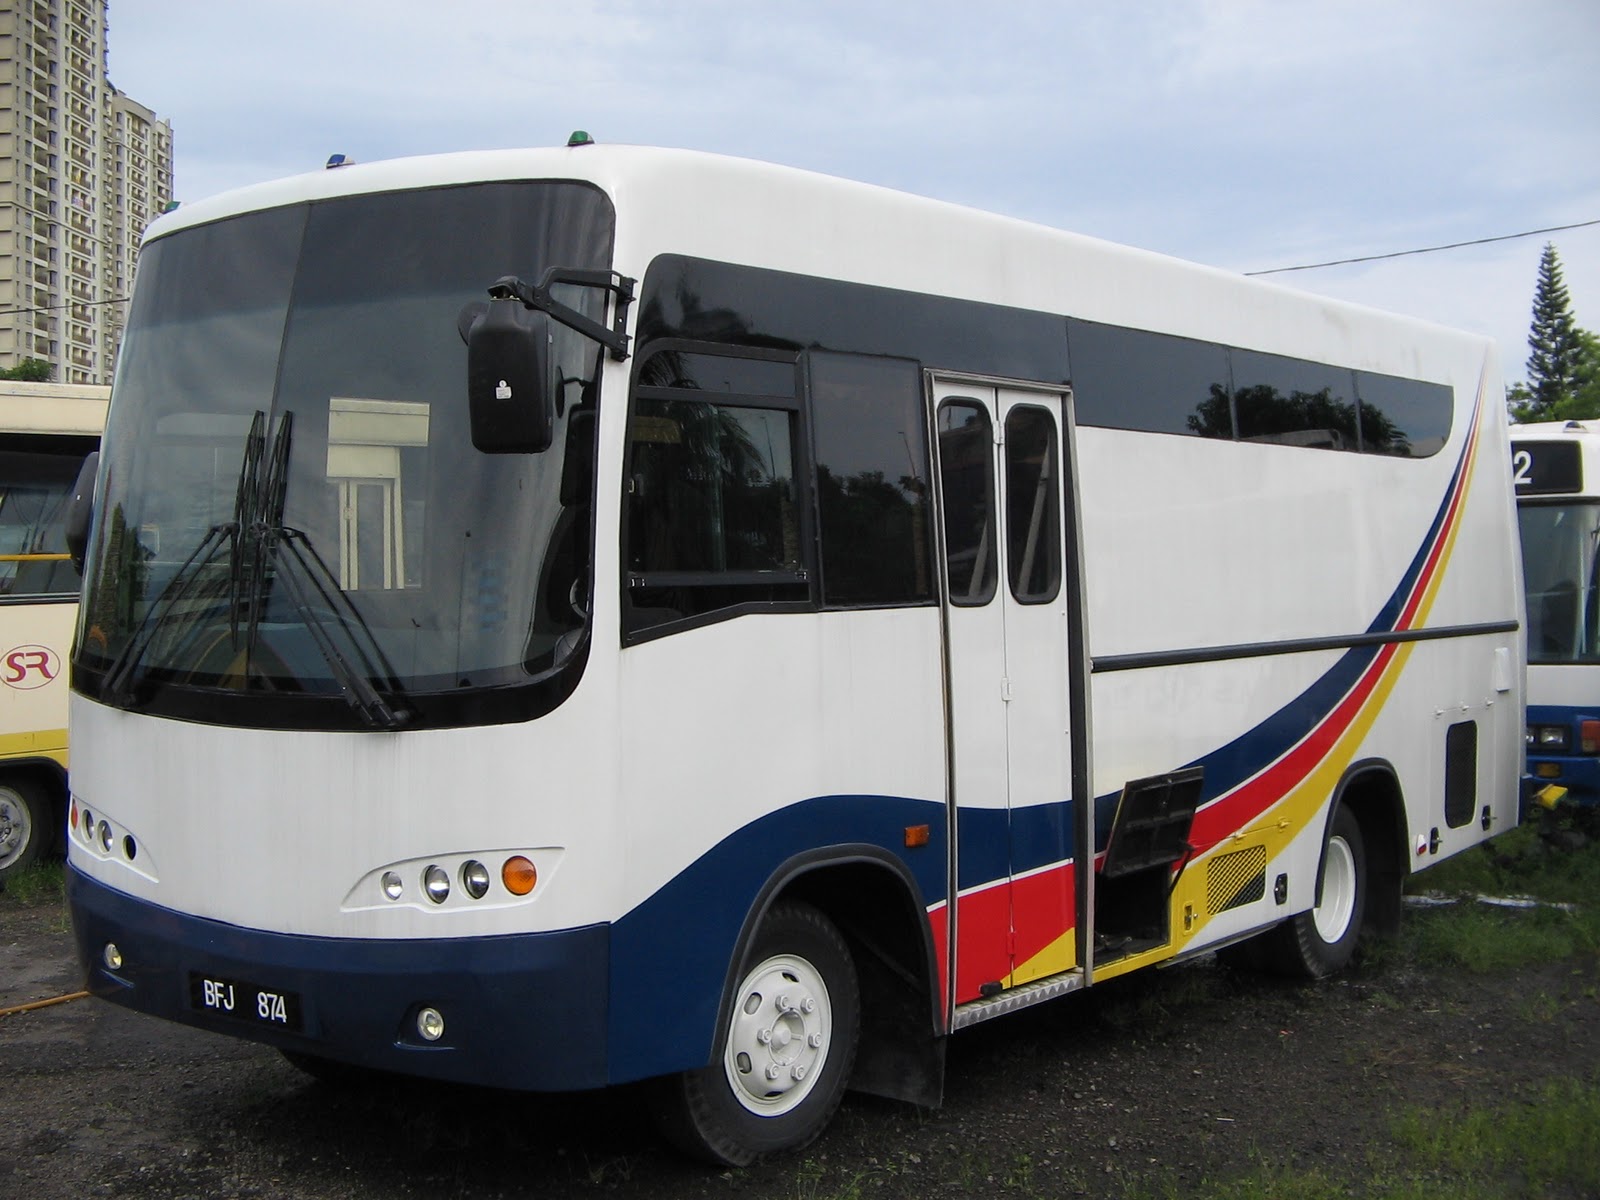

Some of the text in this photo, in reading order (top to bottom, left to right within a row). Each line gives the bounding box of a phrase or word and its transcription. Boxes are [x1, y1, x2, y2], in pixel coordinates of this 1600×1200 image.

[1513, 450, 1533, 484] 2
[6, 651, 54, 683] SR
[203, 979, 287, 1023] BFJ 874
